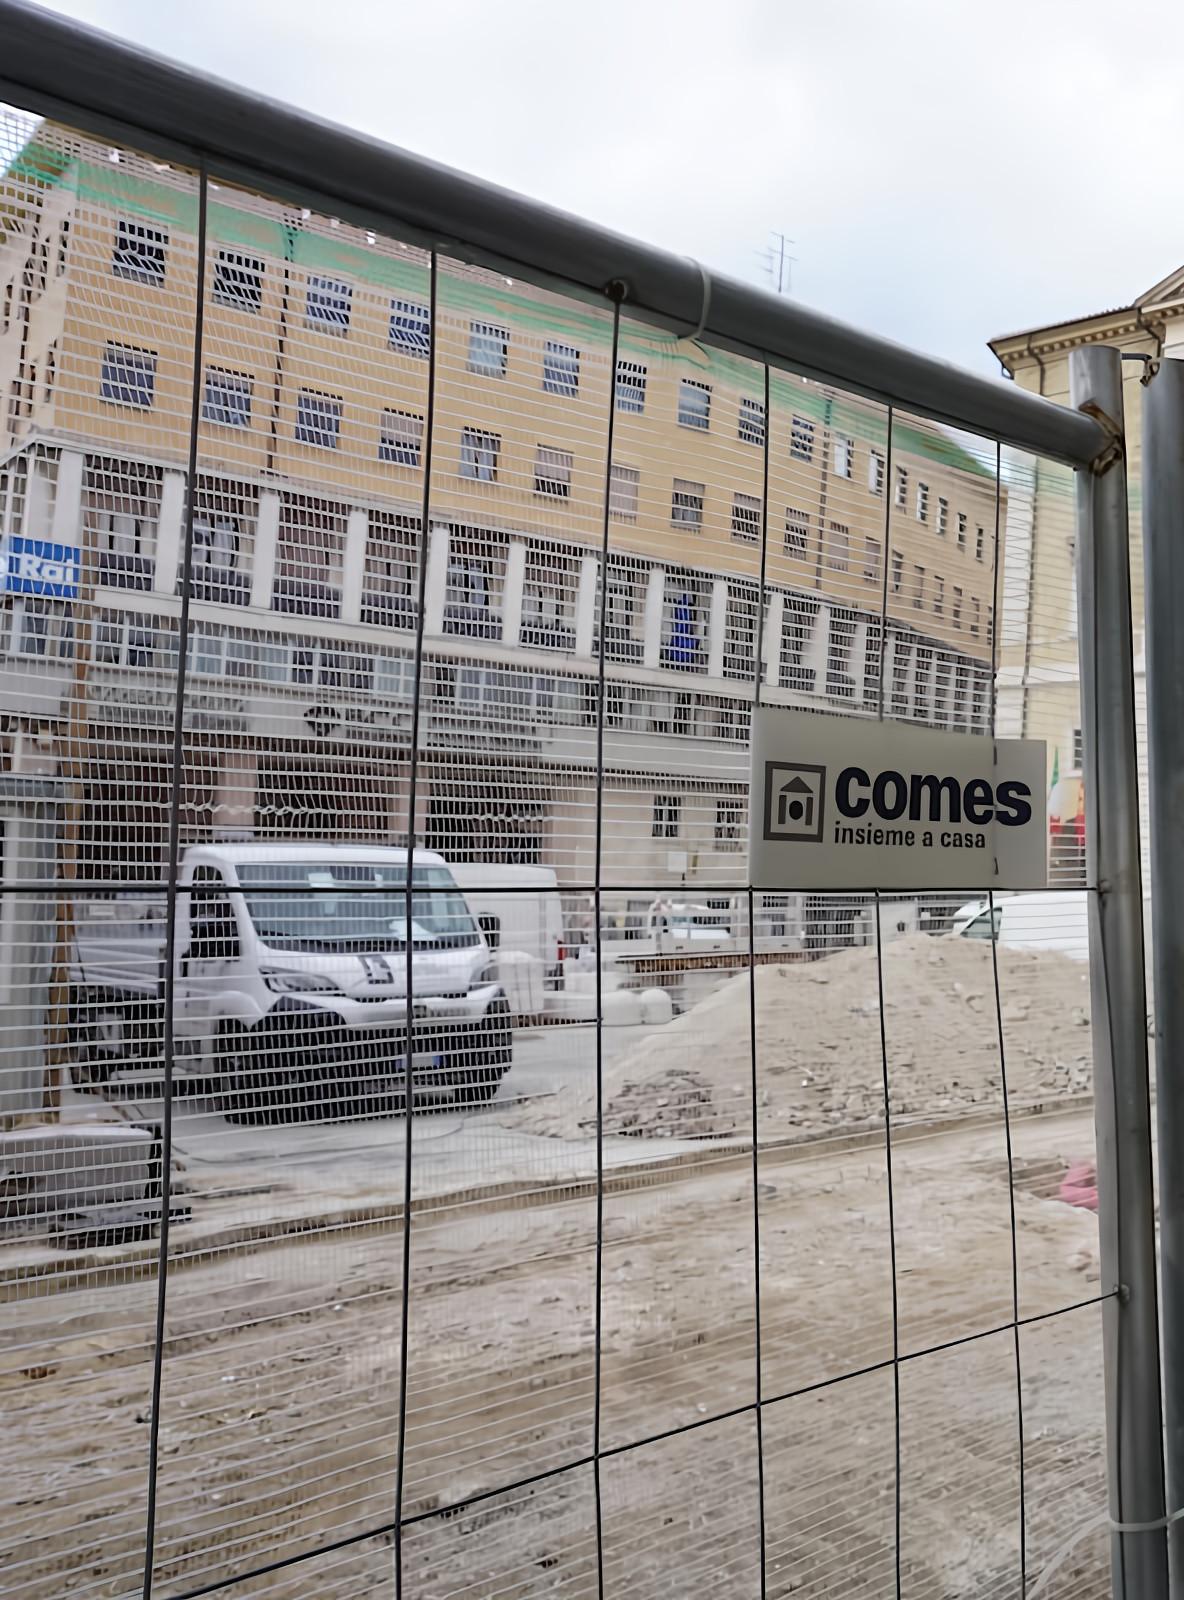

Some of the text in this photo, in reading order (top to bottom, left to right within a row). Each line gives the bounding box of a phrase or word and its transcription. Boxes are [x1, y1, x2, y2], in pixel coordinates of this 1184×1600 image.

[835, 767, 1032, 827] comes
[834, 821, 986, 849] insieme a casa
